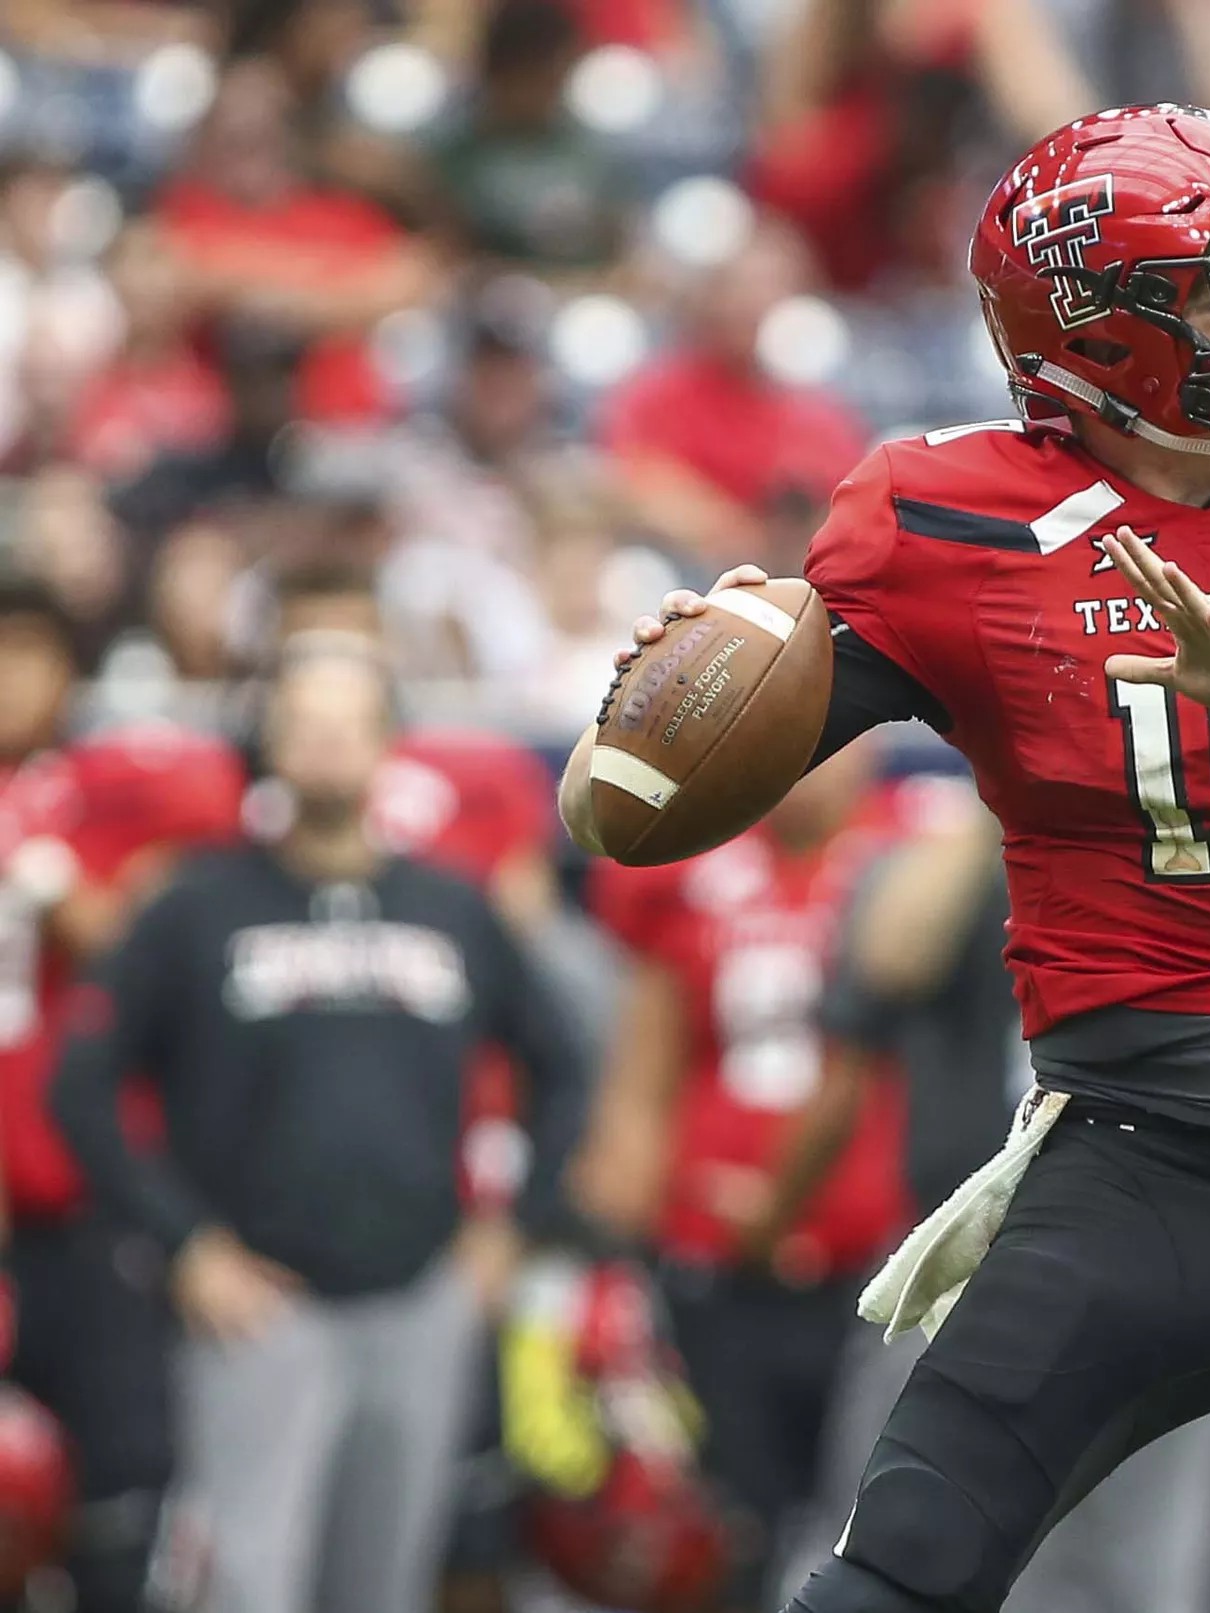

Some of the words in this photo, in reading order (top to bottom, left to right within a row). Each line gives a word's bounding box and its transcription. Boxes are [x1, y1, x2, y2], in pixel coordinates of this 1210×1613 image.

[661, 690, 699, 746] COLLEGE
[695, 635, 746, 691] FOOTBALL
[691, 668, 733, 722] PLAYOFF
